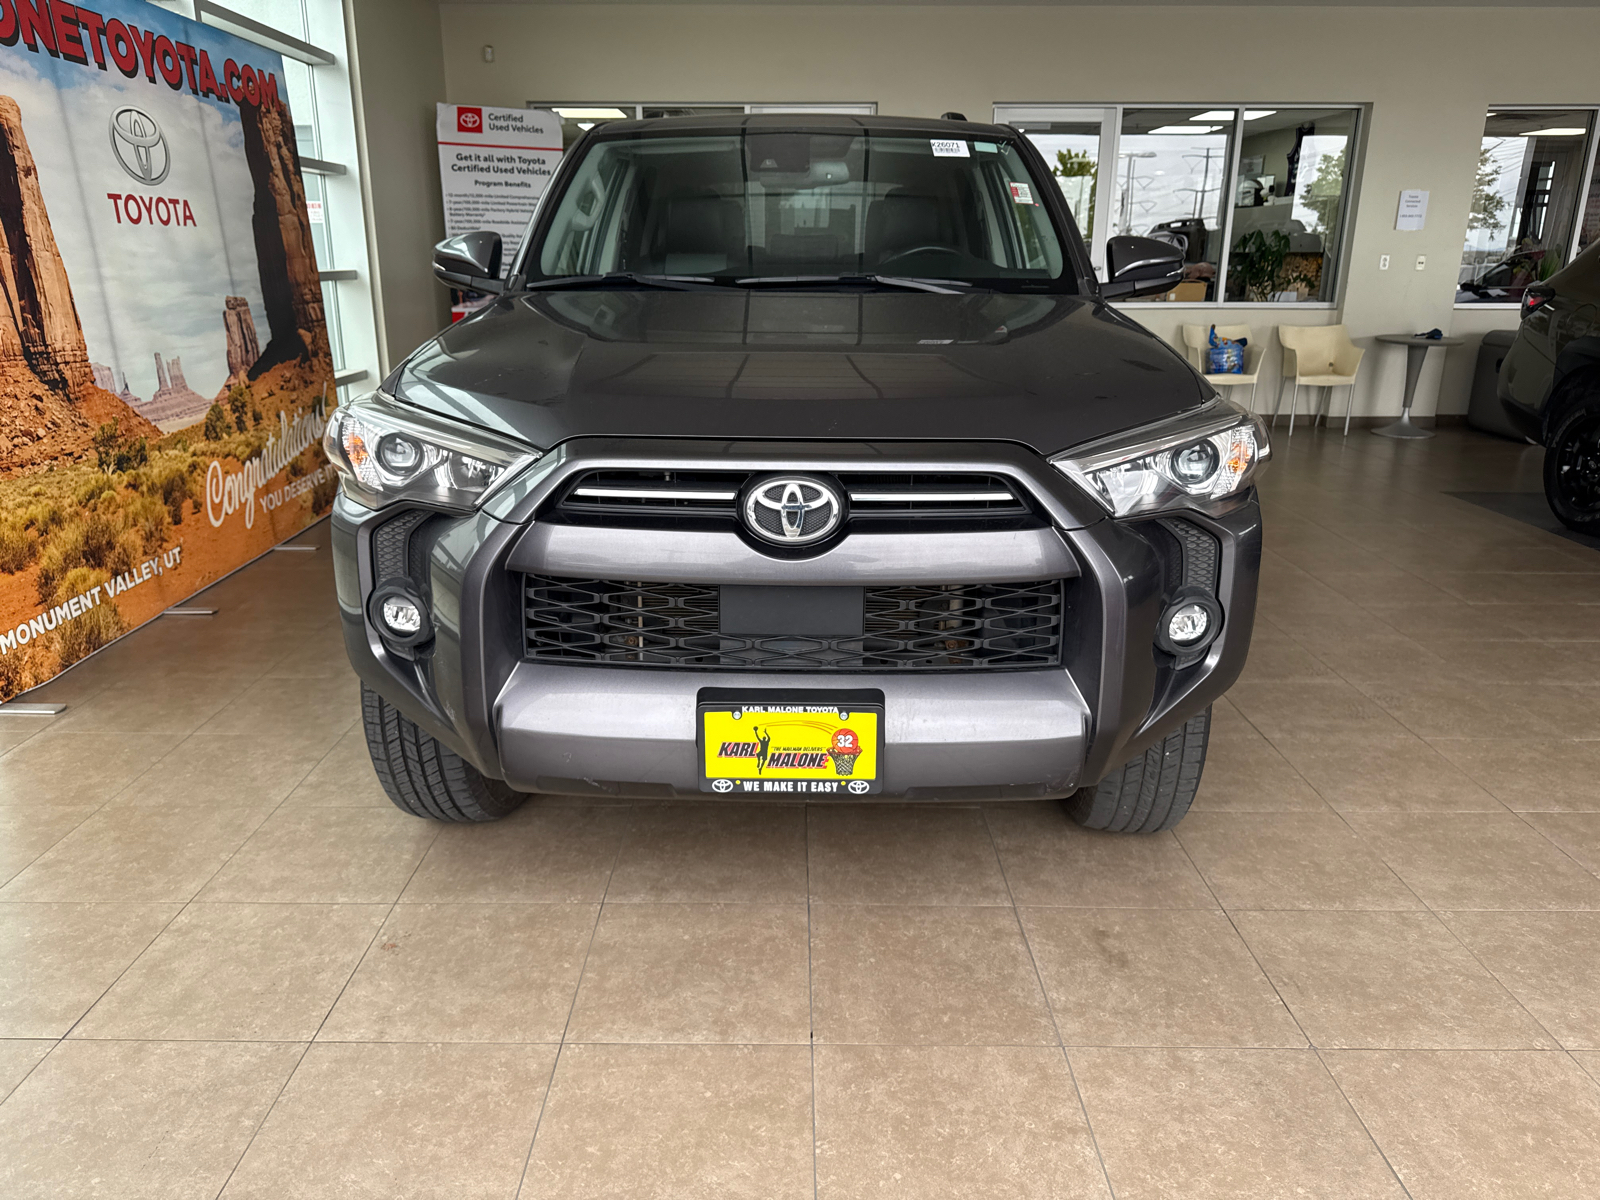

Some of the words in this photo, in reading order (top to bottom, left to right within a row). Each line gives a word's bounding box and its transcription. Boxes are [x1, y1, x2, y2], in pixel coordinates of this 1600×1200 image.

[488, 113, 524, 123] Certified
[489, 123, 510, 132] Used
[511, 124, 544, 134] Vehicles
[455, 153, 473, 162] Get
[474, 153, 482, 162] it
[483, 154, 495, 163] all
[496, 155, 516, 164] with
[517, 156, 546, 166] Toyota
[451, 164, 491, 173] Certified
[492, 165, 514, 174] Used
[516, 166, 551, 176] Vehicles
[474, 180, 503, 188] Program
[107, 193, 197, 227] TOYOTA
[260, 489, 282, 513] YOU
[284, 468, 325, 502] DESERVE
[0, 586, 102, 654] MONUMENT
[104, 557, 163, 598] VALLEY,
[163, 546, 182, 570] UT
[837, 734, 853, 748] 32
[717, 741, 759, 758] KARL
[766, 752, 828, 769] MALONE
[743, 781, 760, 792] WE
[764, 781, 794, 792] MAKE
[797, 781, 808, 792] IT
[811, 781, 838, 792] EASY
